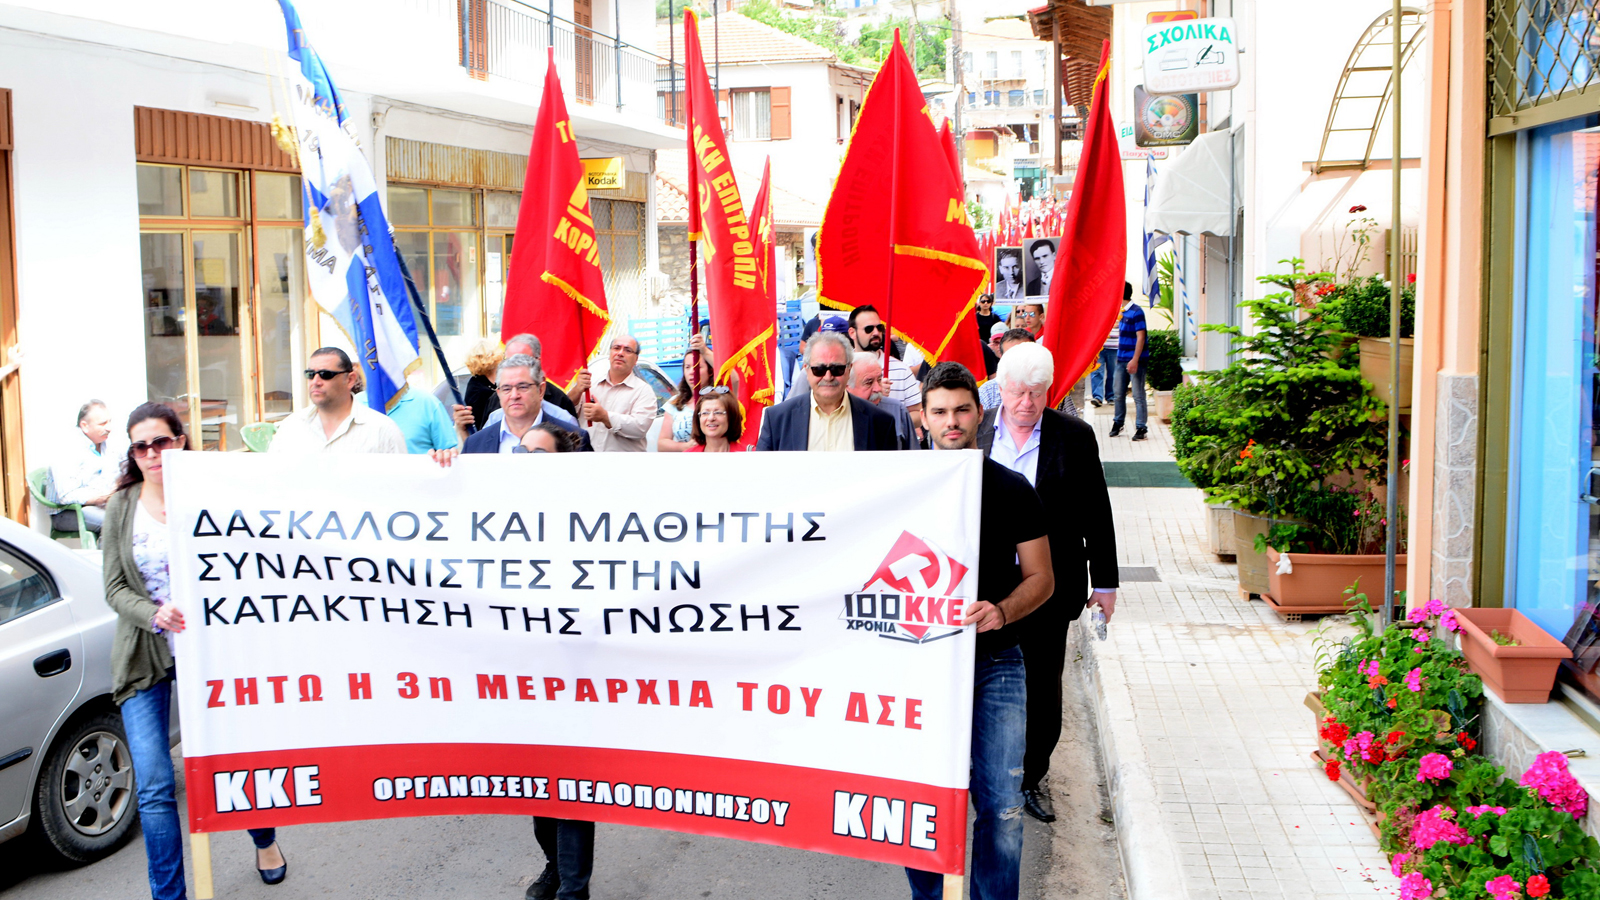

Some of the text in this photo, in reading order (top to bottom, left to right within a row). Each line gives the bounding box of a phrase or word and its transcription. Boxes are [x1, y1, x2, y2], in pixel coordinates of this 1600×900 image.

[1147, 24, 1233, 54] ΣΧΟΛΙΚΑ
[588, 176, 617, 185] Kodak
[711, 171, 757, 290] ΕΠΙΤΡΟΠΗ
[193, 509, 826, 543] ΔΑΣΚΑΛΟΣ ΚΑΙ ΜΑΘΗΤΗΣ
[198, 552, 701, 590] ΣΥΝΑΓΩΝΙΣΤΕΣ ΣΤΗΝ
[203, 595, 801, 635] ΚΑΤΑΚΤΗΣΗ ΤΗΣ ΓΝΩΣΗΣ
[846, 620, 896, 633] ΧΡΟΝΙΑ
[207, 672, 922, 729] ΖΗΤΩ Η 3η ΜΕΡΑΡΧΙΑ ΤΟΥ ΔΣΕ
[213, 765, 323, 813] ΚΚΕ
[373, 775, 790, 826] ΟΡΓΑΝΩΣΕΙΣ ΠΕΛΟΠΟΝΝΗΣΟΥ
[832, 790, 938, 851] ΚΝΕ
